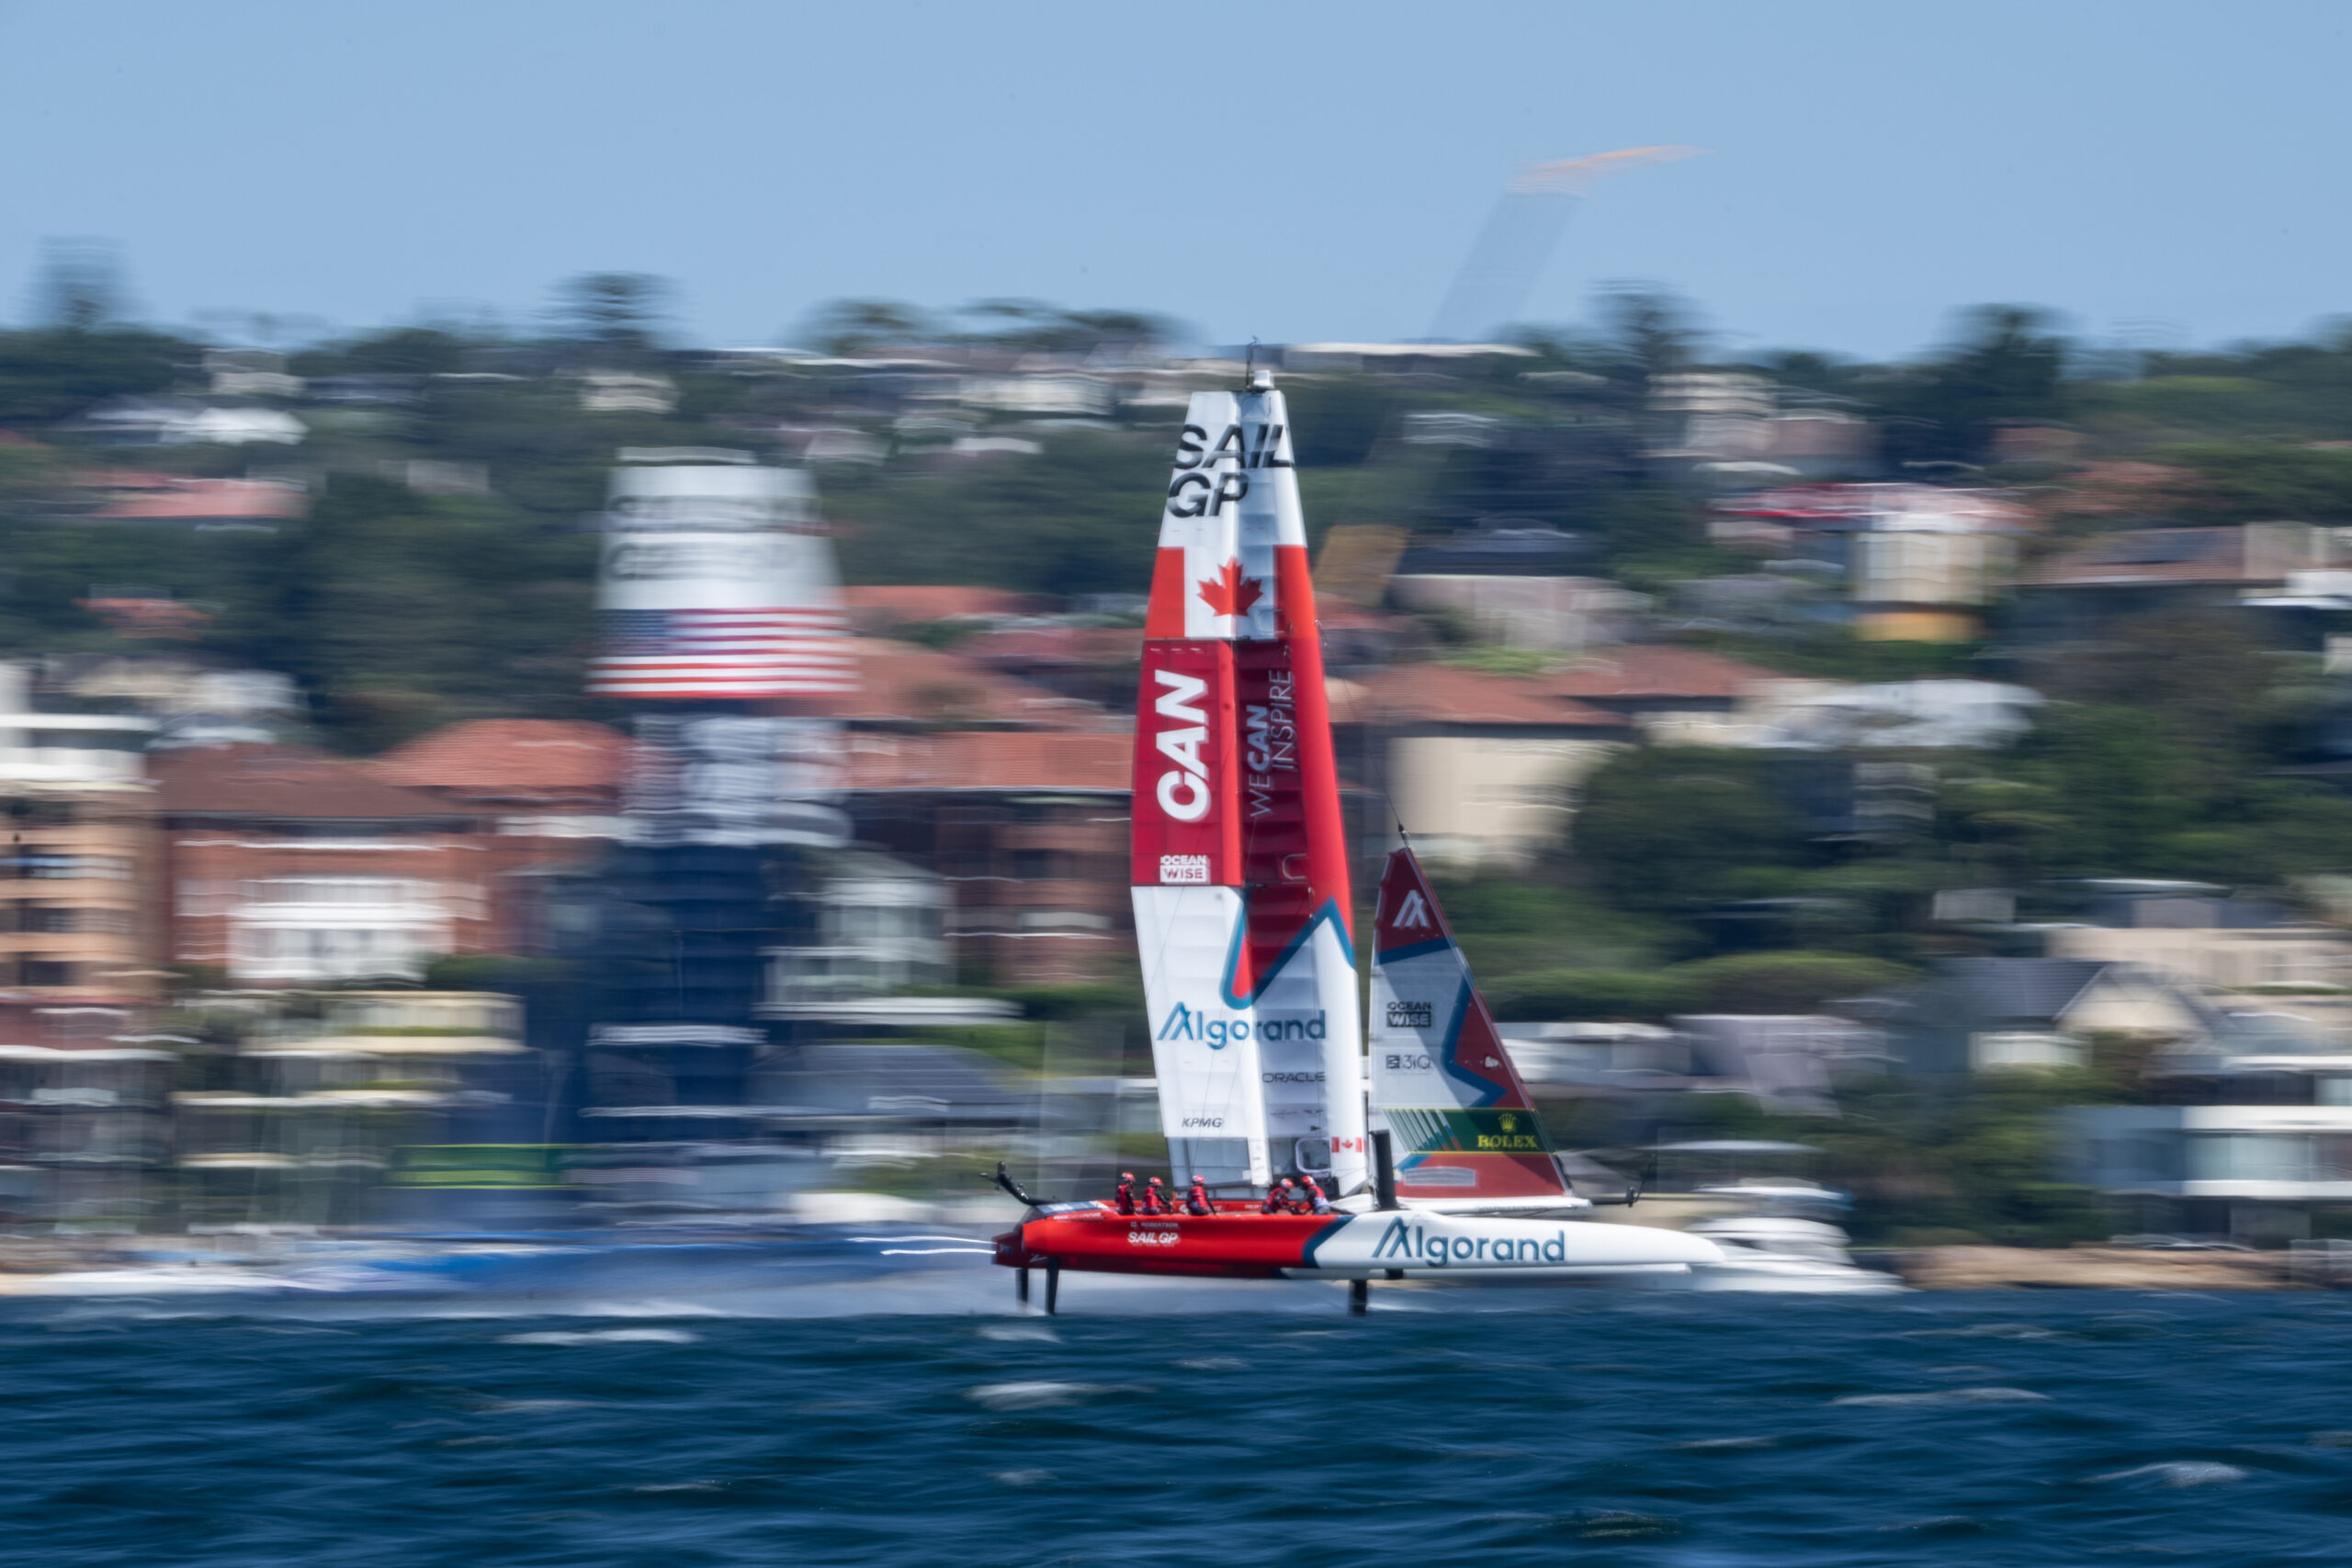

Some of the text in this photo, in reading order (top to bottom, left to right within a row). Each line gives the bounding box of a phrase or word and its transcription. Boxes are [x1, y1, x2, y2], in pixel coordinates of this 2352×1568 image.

[1174, 424, 1295, 469] SAIL
[1167, 472, 1249, 517] GP
[1269, 671, 1294, 769] INSPIRE
[1155, 670, 1209, 822] CAN
[1246, 705, 1272, 817] WE CAN
[1160, 854, 1206, 864] OCEAN
[1163, 868, 1204, 879] WISE
[1387, 1001, 1431, 1010] OCEAN
[1388, 1013, 1430, 1025] WISE
[1157, 1001, 1326, 1050] Algorand
[1262, 1072, 1326, 1083] ORACLE
[1182, 1118, 1223, 1128] KPMG
[1477, 1134, 1537, 1148] ROLEX
[1372, 1216, 1566, 1267] Algorand
